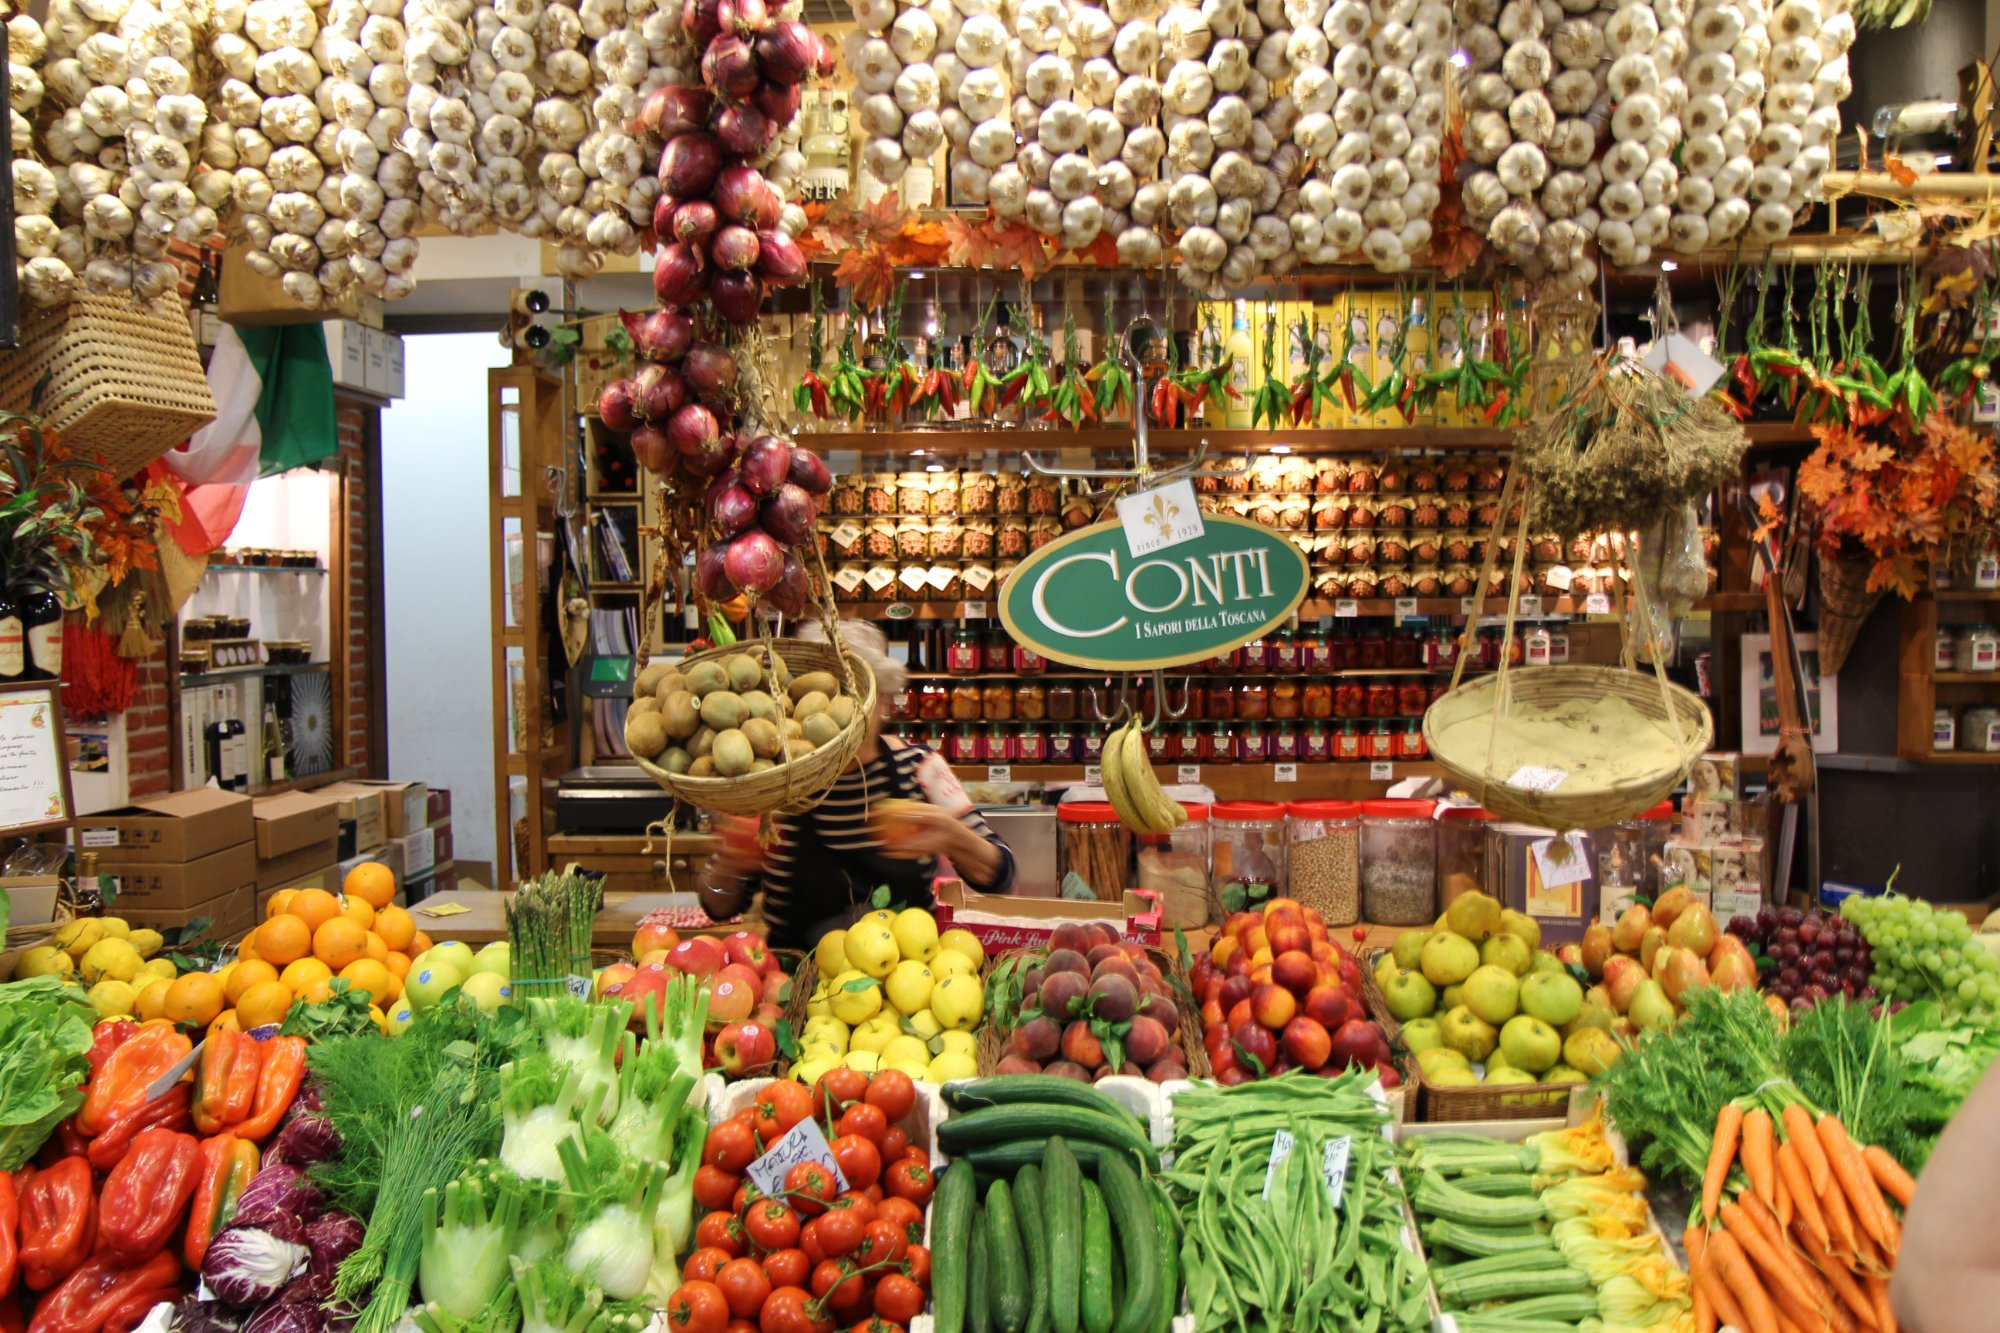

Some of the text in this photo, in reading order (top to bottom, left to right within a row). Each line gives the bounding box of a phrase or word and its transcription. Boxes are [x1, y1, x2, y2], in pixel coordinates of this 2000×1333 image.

[1136, 524, 1199, 553] since 1929
[1032, 546, 1277, 639] CONTI
[1135, 609, 1267, 639] I SAPORI DELLA TOSCANA
[981, 928, 1021, 946] Pink
